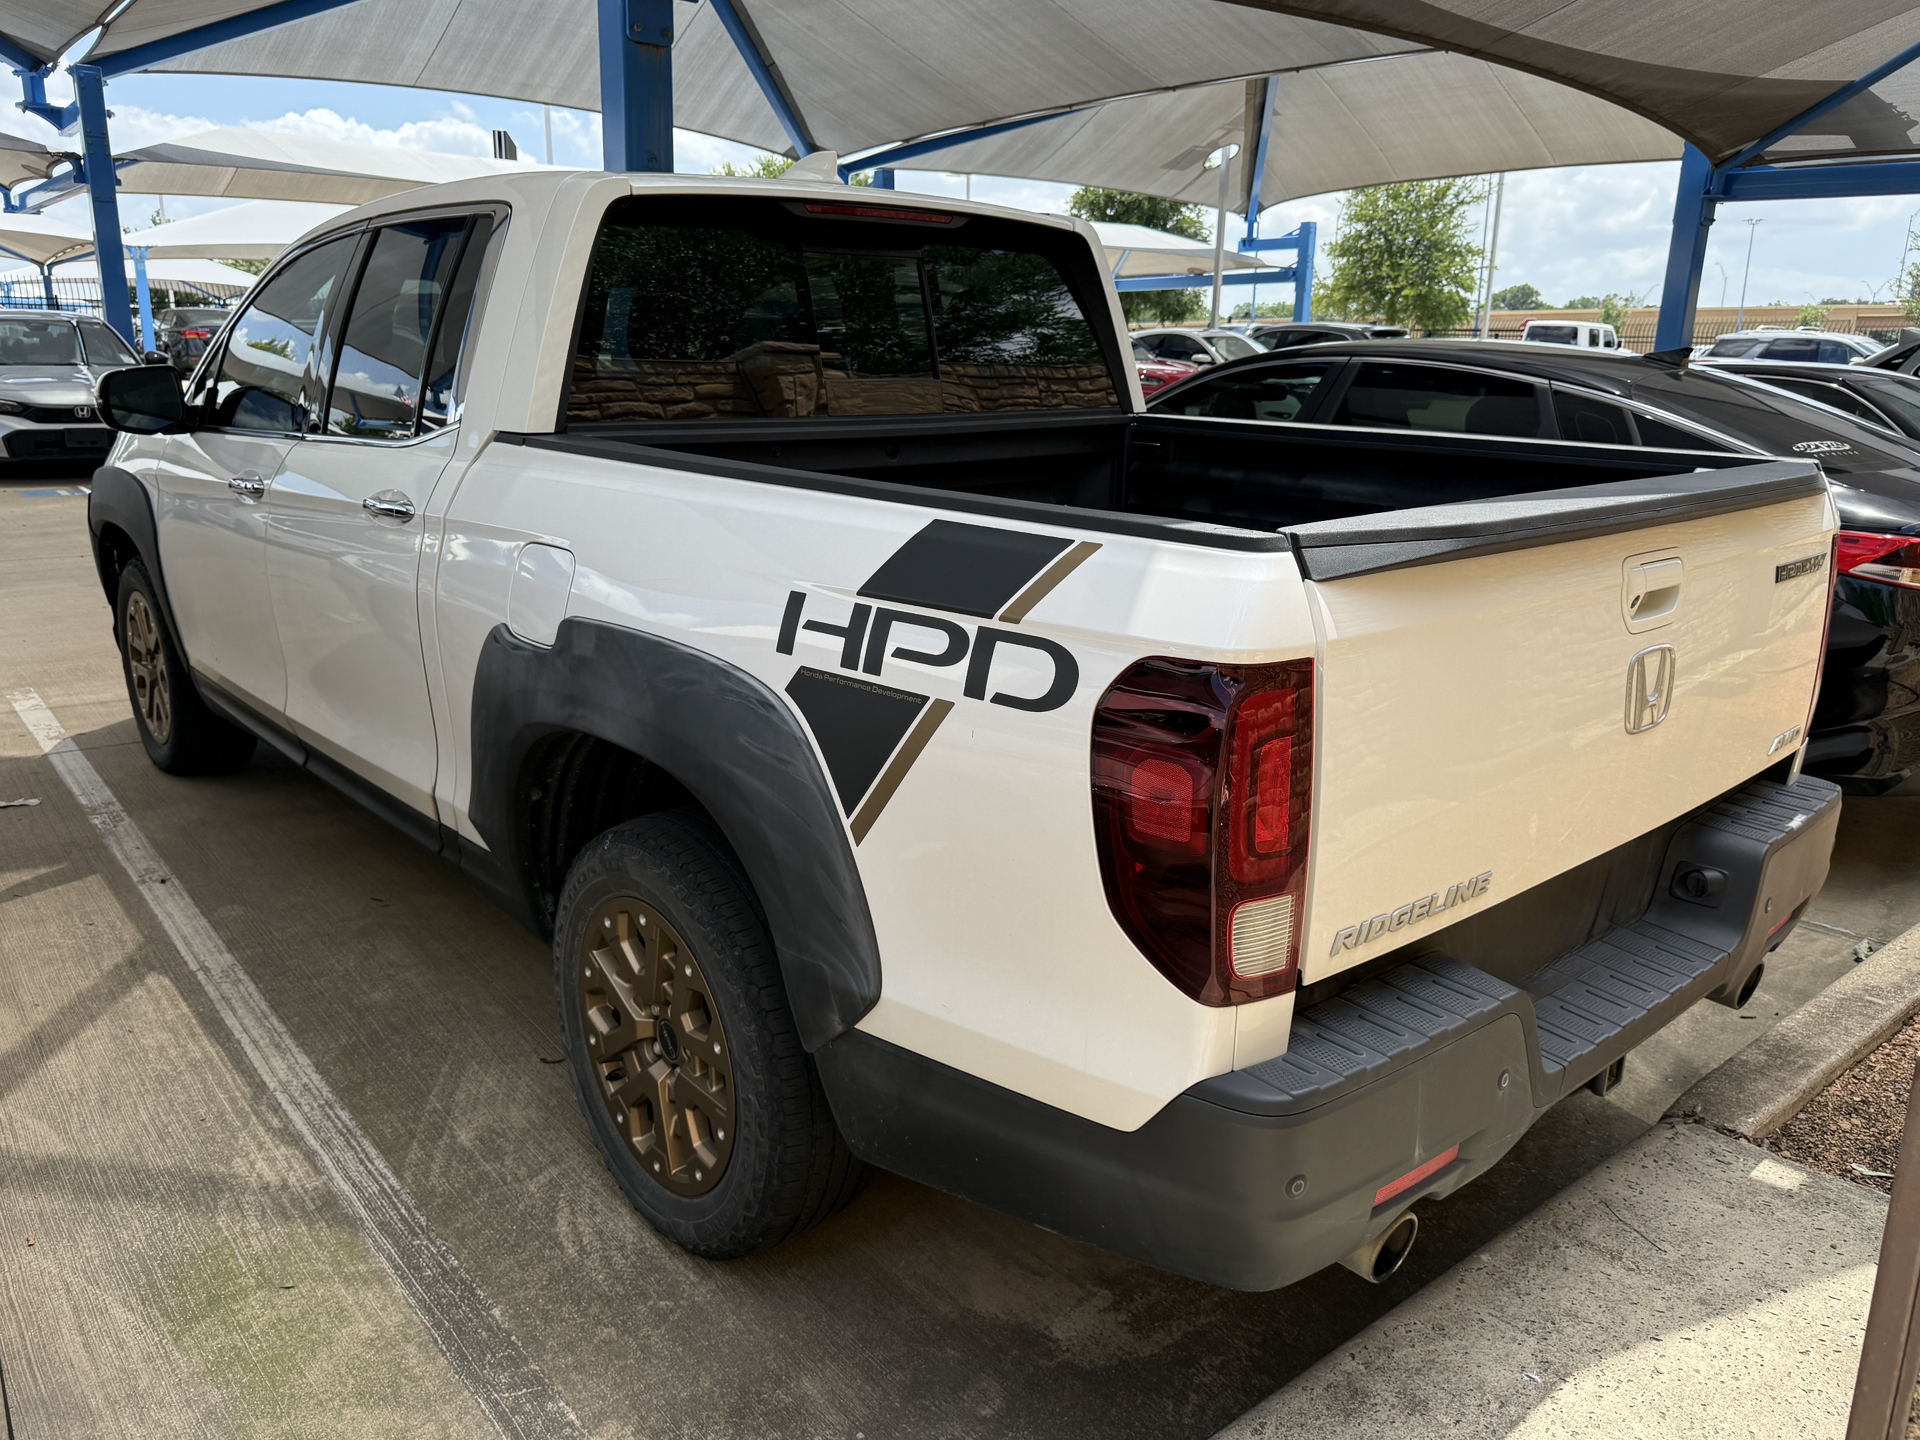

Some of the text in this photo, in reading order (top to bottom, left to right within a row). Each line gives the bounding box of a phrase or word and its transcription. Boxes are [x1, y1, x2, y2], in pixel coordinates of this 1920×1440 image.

[775, 590, 1080, 713] HPD
[800, 668, 922, 704] Honda Performance Development
[1767, 725, 1801, 756] AWD
[1329, 870, 1493, 958] RIDGELINE
